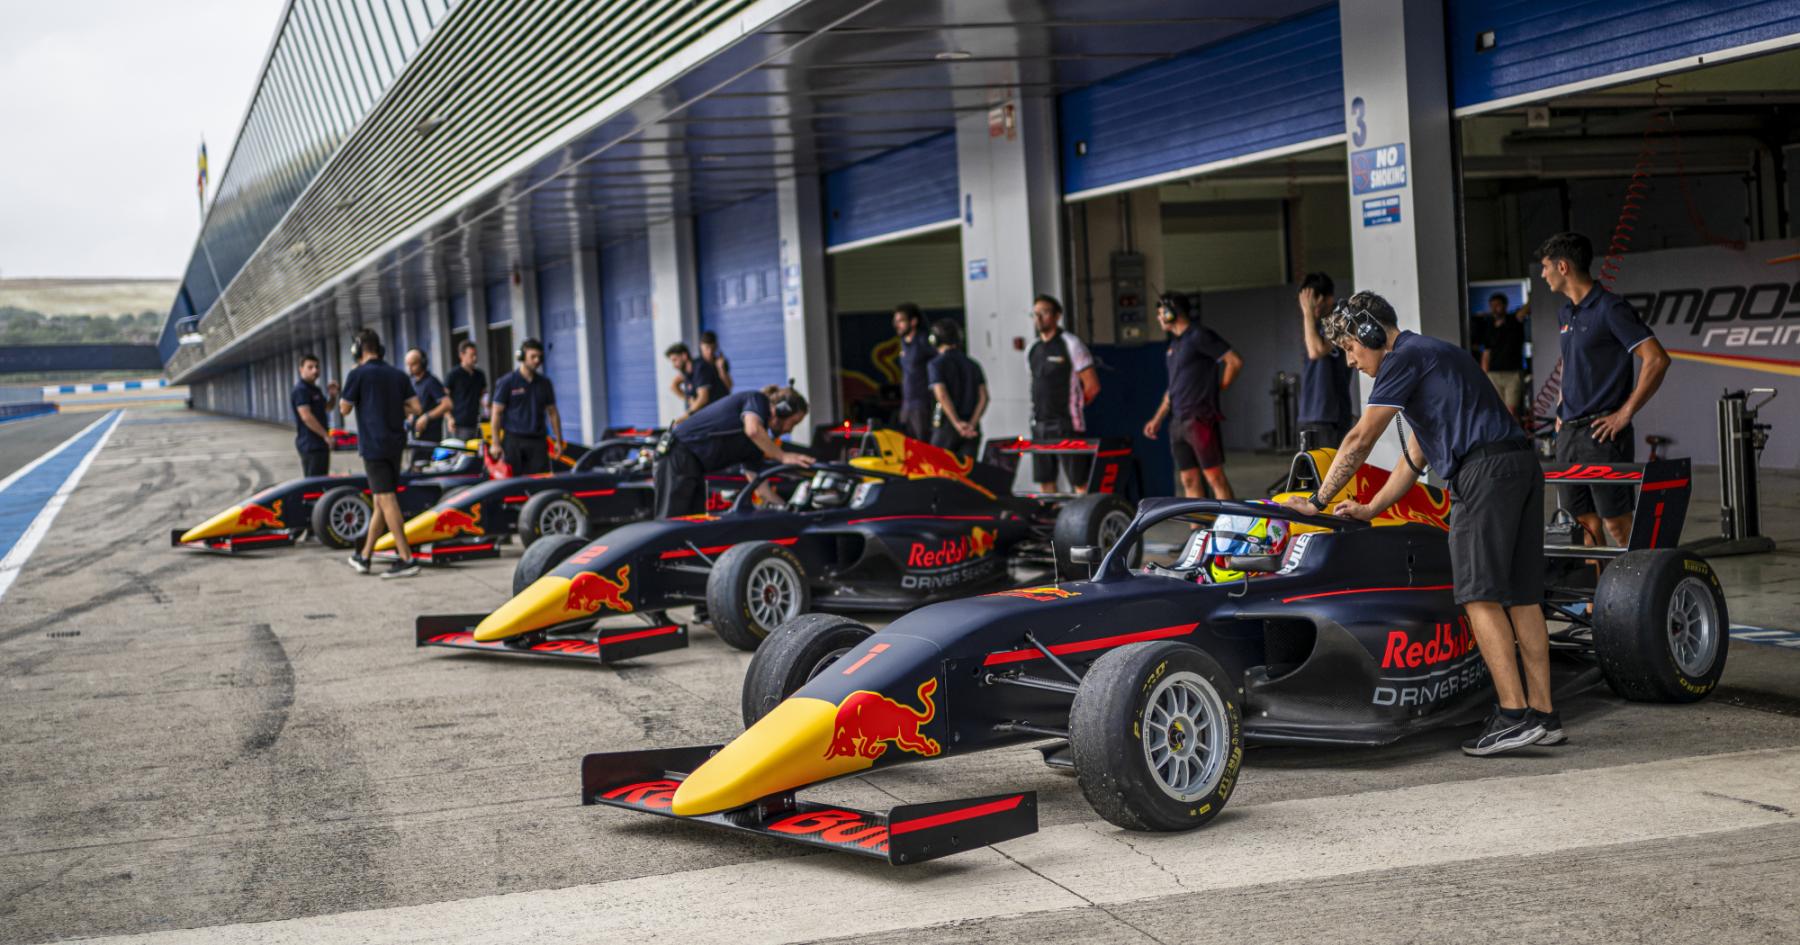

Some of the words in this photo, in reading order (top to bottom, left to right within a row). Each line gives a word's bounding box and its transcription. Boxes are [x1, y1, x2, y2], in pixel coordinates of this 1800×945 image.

[1351, 96, 1367, 148] 3
[1376, 147, 1398, 168] NO
[1371, 165, 1405, 189] SMOKING
[1623, 281, 1800, 335] ampo
[1702, 325, 1800, 347] racin
[1099, 464, 1118, 494] 2
[568, 545, 609, 564] 2
[1372, 676, 1459, 706] DRIVER
[1218, 746, 1242, 800] PIRELLI
[600, 779, 682, 808] Re
